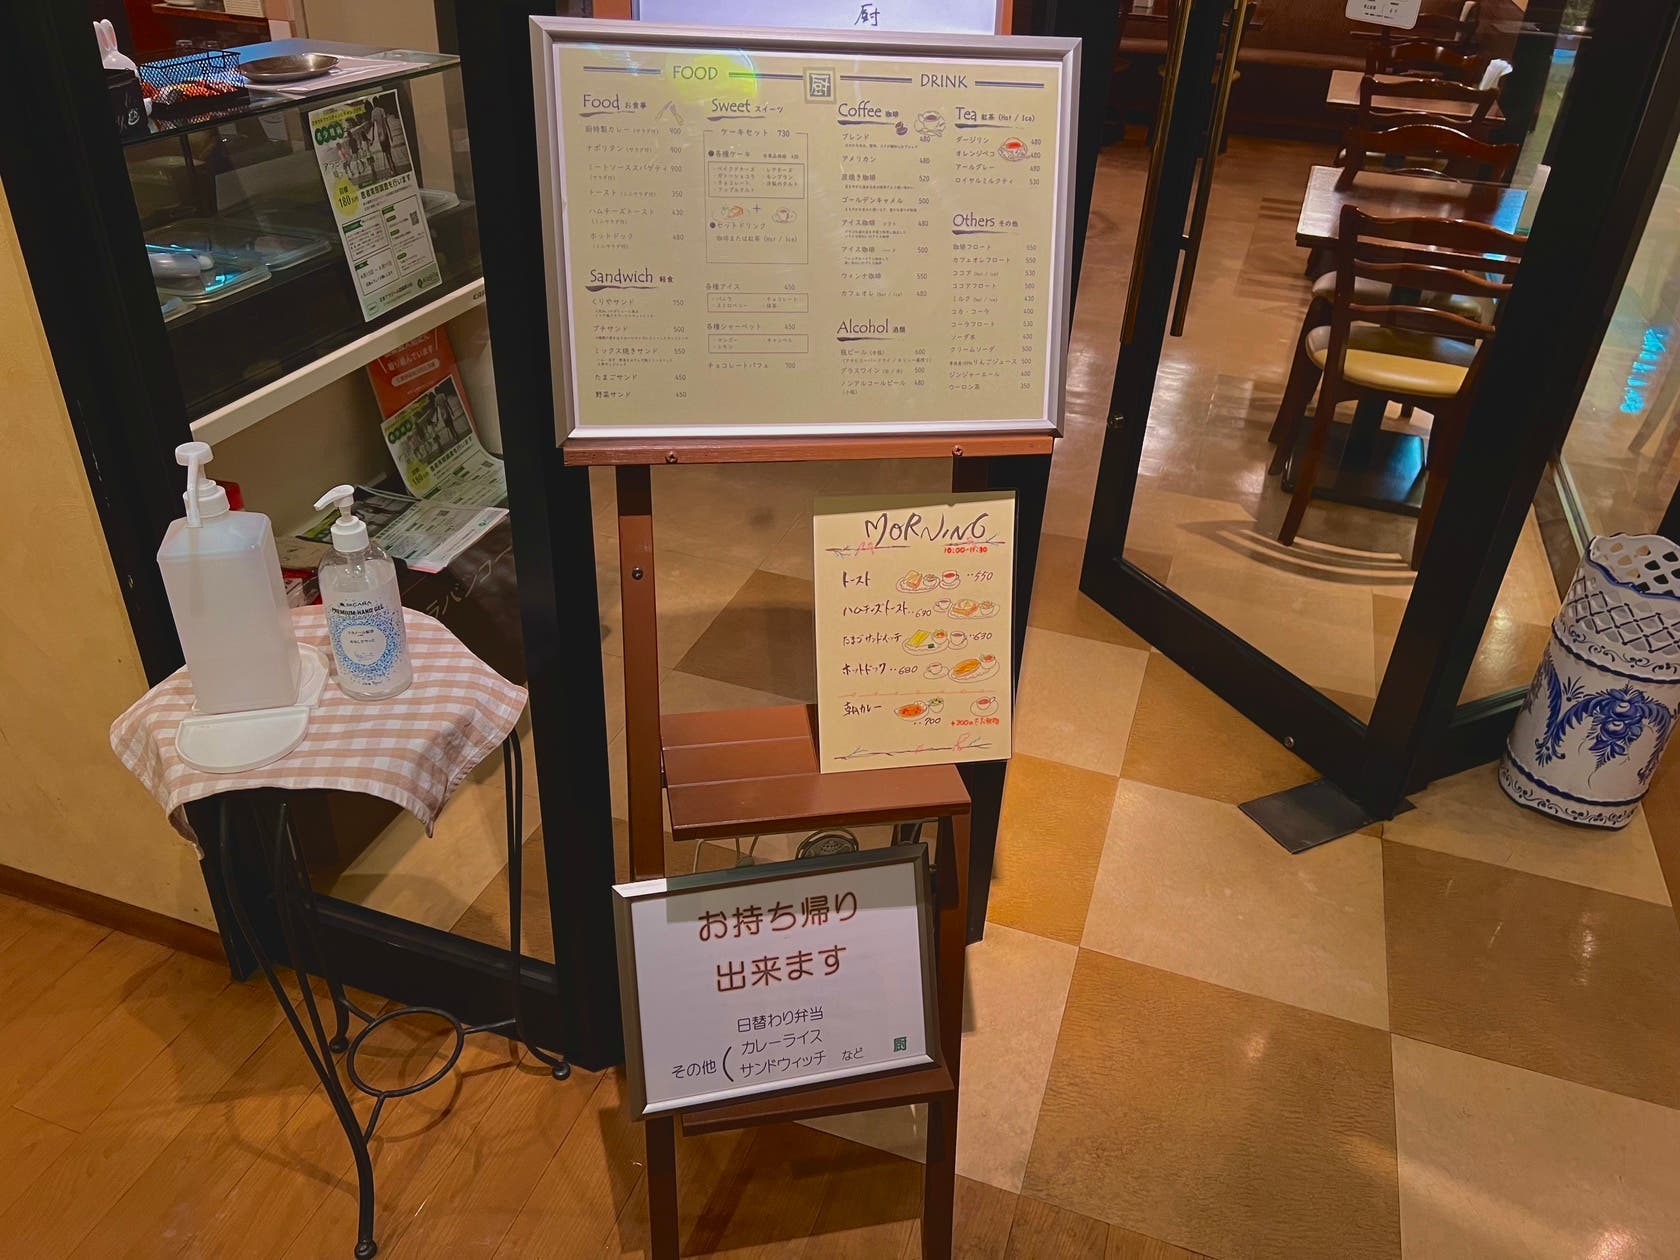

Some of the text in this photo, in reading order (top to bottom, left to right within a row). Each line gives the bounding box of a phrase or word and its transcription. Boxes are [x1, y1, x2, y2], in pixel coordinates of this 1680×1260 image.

[854, 3, 880, 26] 厨
[673, 65, 719, 80] FOOD
[920, 73, 968, 88] DRINK
[583, 93, 620, 110] Food
[711, 98, 784, 113] Sweet スイーツ
[838, 100, 882, 118] Coffee
[955, 106, 977, 122] Tea
[720, 128, 790, 138] ケーキセット 730
[842, 133, 870, 141] ブレンド
[955, 136, 990, 144] ダージリン
[587, 144, 624, 152] ナポリタン
[955, 150, 995, 158] オレンジペコ
[842, 155, 877, 163] アメリカン
[955, 163, 995, 171] アールグレー
[918, 174, 930, 182] 520
[954, 177, 1014, 185] ロイヤルミルクティ
[589, 189, 617, 197] トースト
[841, 196, 930, 205] ゴールデンキャメル 500
[588, 207, 654, 216] ハムチーズトースト
[952, 211, 995, 228] Others
[917, 245, 929, 254] 500
[590, 267, 653, 284] Sandwich
[840, 289, 874, 298] カフェオレ
[592, 298, 634, 306] くりやサンド
[951, 308, 990, 316] コカ・コーラ
[593, 324, 685, 333] プチサンド 500
[837, 318, 889, 334] Alcohol
[950, 345, 996, 353] クリームソーダ
[840, 366, 926, 375] グラスワイン 500
[949, 371, 1000, 379] ジンジャーエール
[595, 373, 638, 381] たまごサンド
[595, 391, 631, 399] 野菜サンド
[865, 512, 989, 547] MORNING
[842, 571, 993, 588] トースト 550
[973, 631, 993, 640] 630
[898, 665, 919, 675] 680
[924, 716, 942, 726] 700
[698, 891, 858, 942] お持ち帰り
[716, 944, 847, 993] 出来ます
[737, 1006, 824, 1033] 日替わり弁当
[741, 1029, 823, 1056] カレーライス
[671, 1047, 864, 1079] その他 サンドウィッチ など
